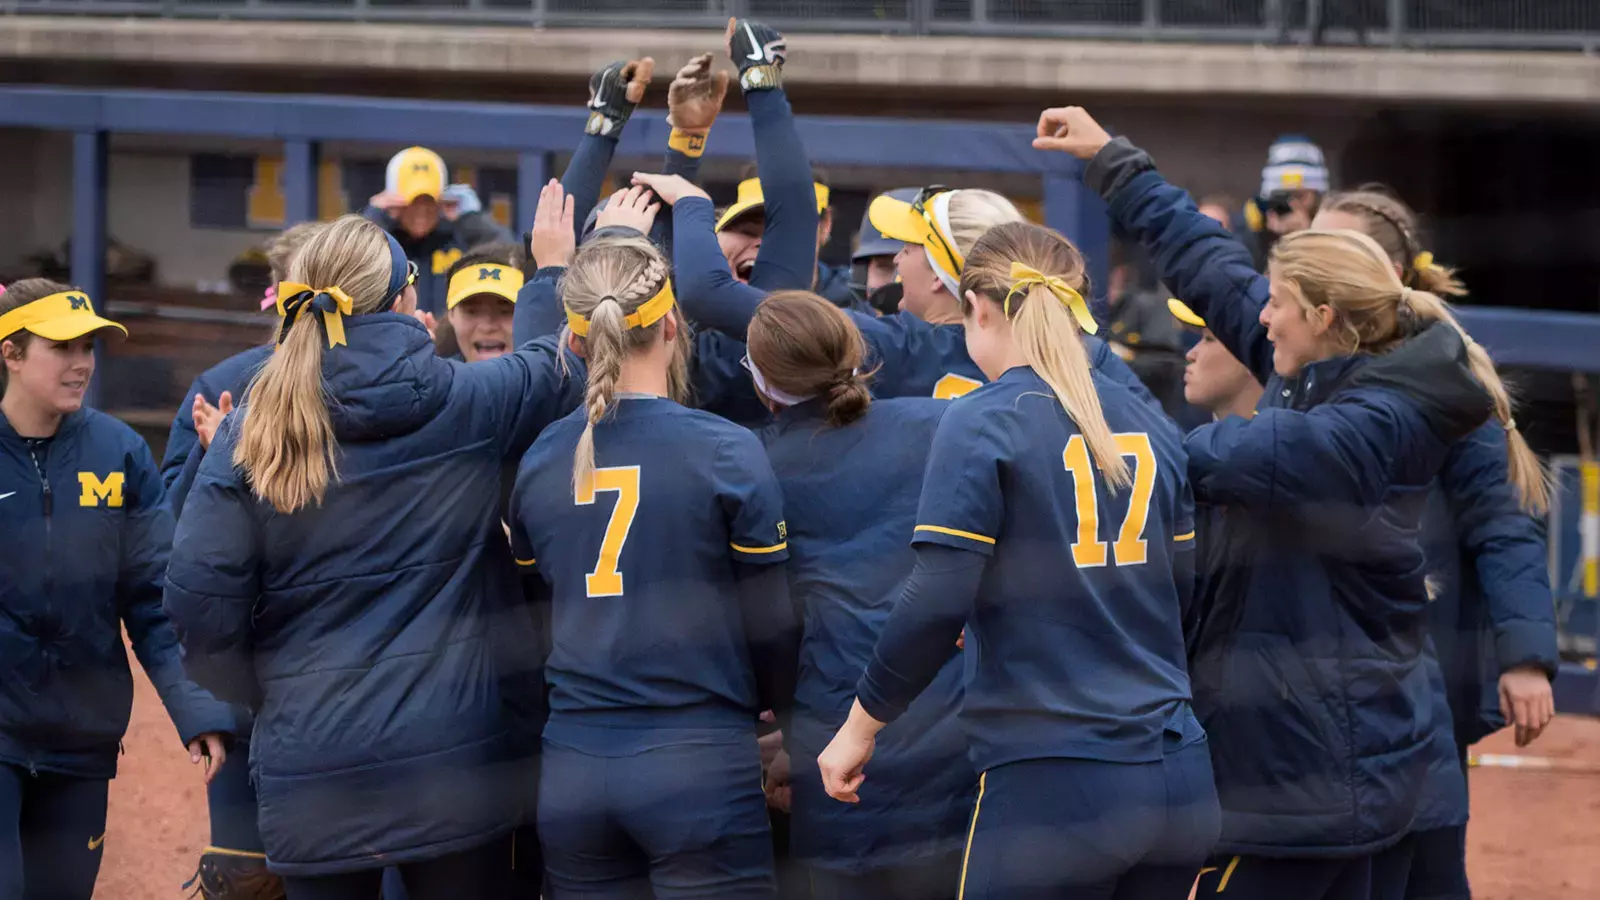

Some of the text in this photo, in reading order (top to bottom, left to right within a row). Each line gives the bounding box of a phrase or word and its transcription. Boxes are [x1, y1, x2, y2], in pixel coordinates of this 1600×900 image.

[479, 268, 501, 280] M
[66, 295, 90, 311] M
[78, 471, 125, 507] M
[1063, 432, 1157, 568] 17
[575, 465, 640, 598] 7
